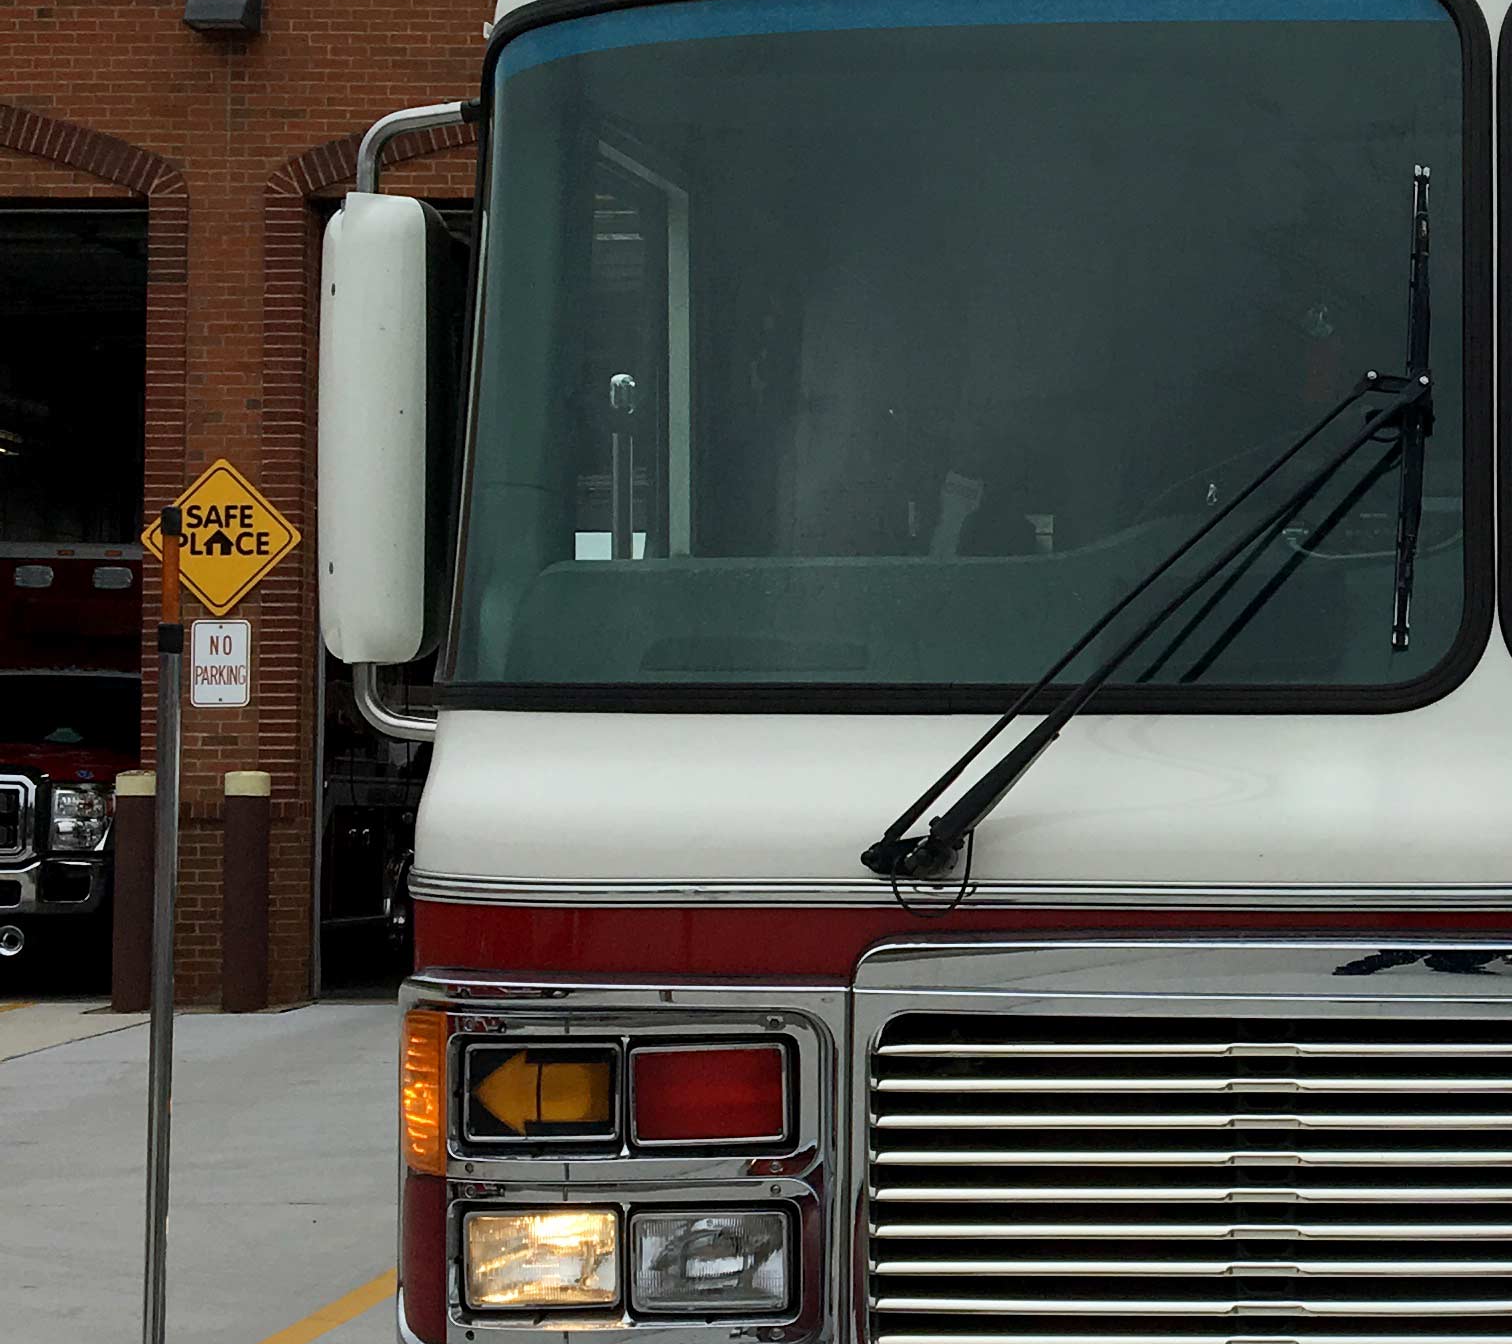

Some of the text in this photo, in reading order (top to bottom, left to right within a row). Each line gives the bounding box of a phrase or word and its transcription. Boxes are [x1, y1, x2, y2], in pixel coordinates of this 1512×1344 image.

[186, 504, 254, 529] SAFE
[209, 635, 233, 655] NO
[195, 664, 247, 686] PARKING
